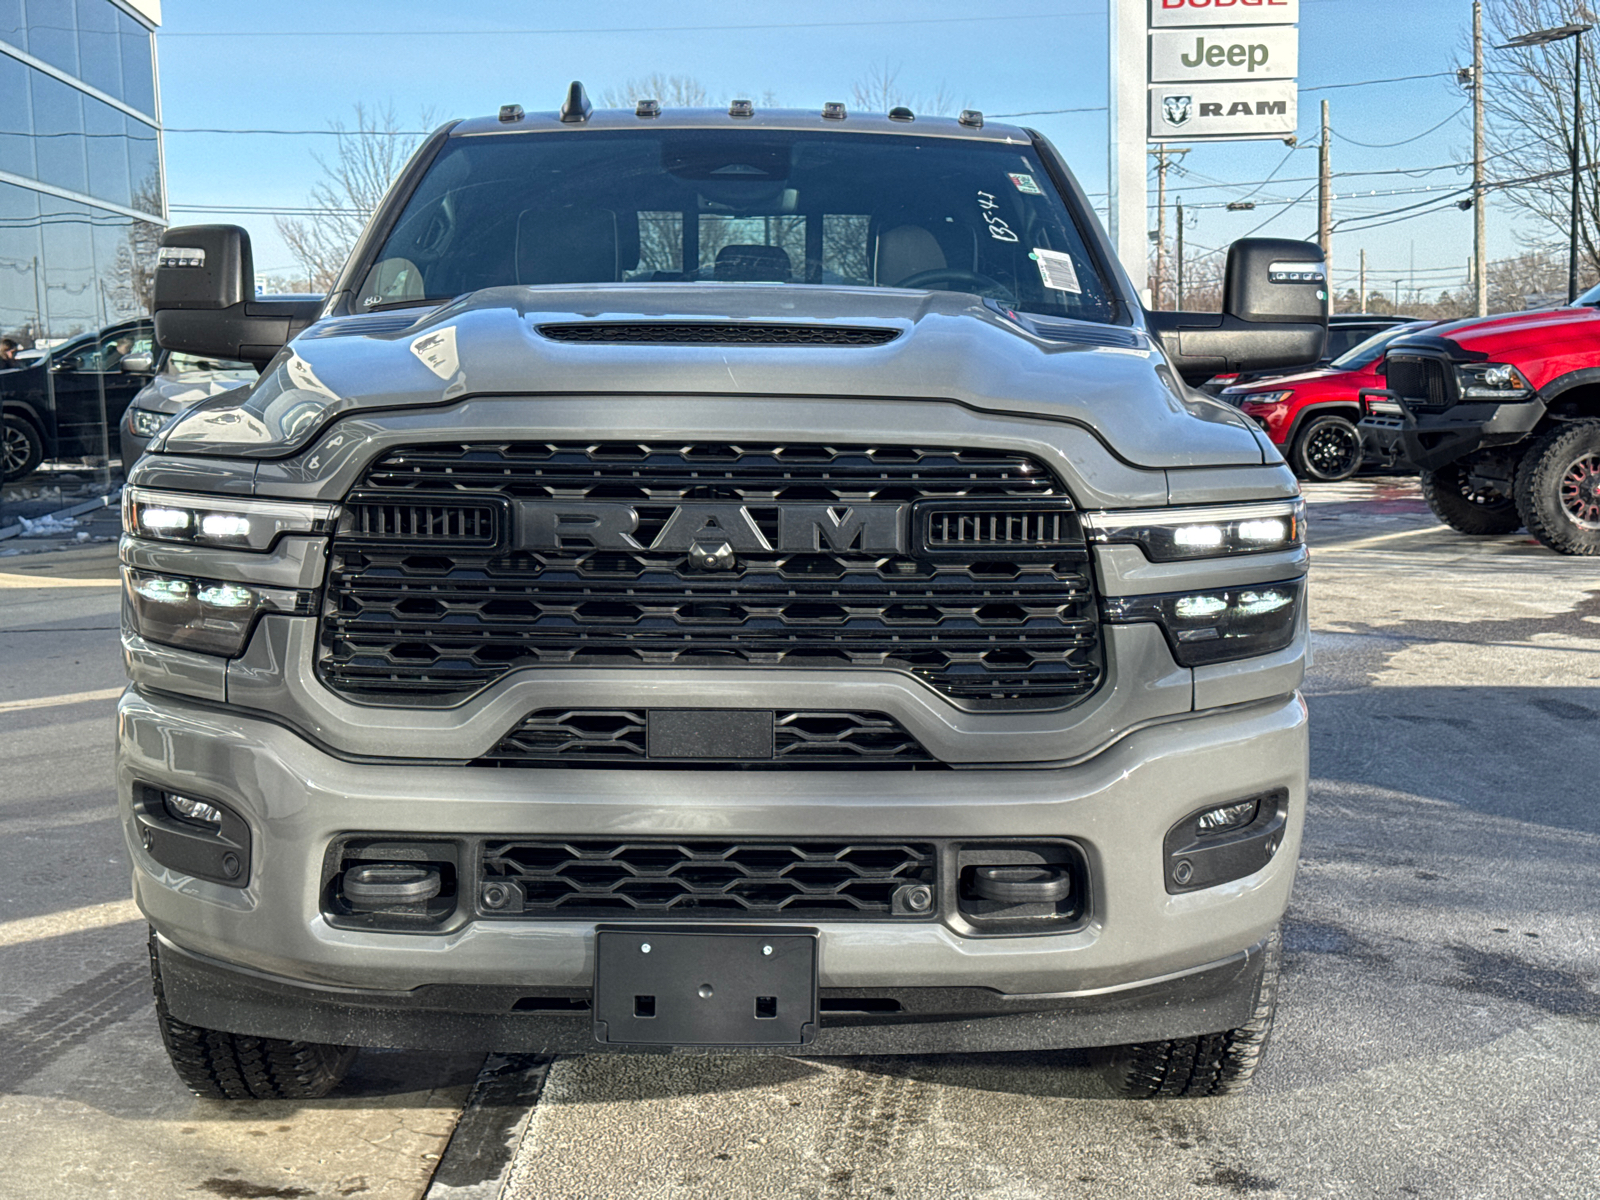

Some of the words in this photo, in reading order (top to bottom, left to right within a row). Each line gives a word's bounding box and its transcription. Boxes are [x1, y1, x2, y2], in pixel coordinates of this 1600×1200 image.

[1181, 37, 1269, 72] Jeep
[1199, 101, 1287, 117] RAM
[519, 502, 902, 552] RAM
